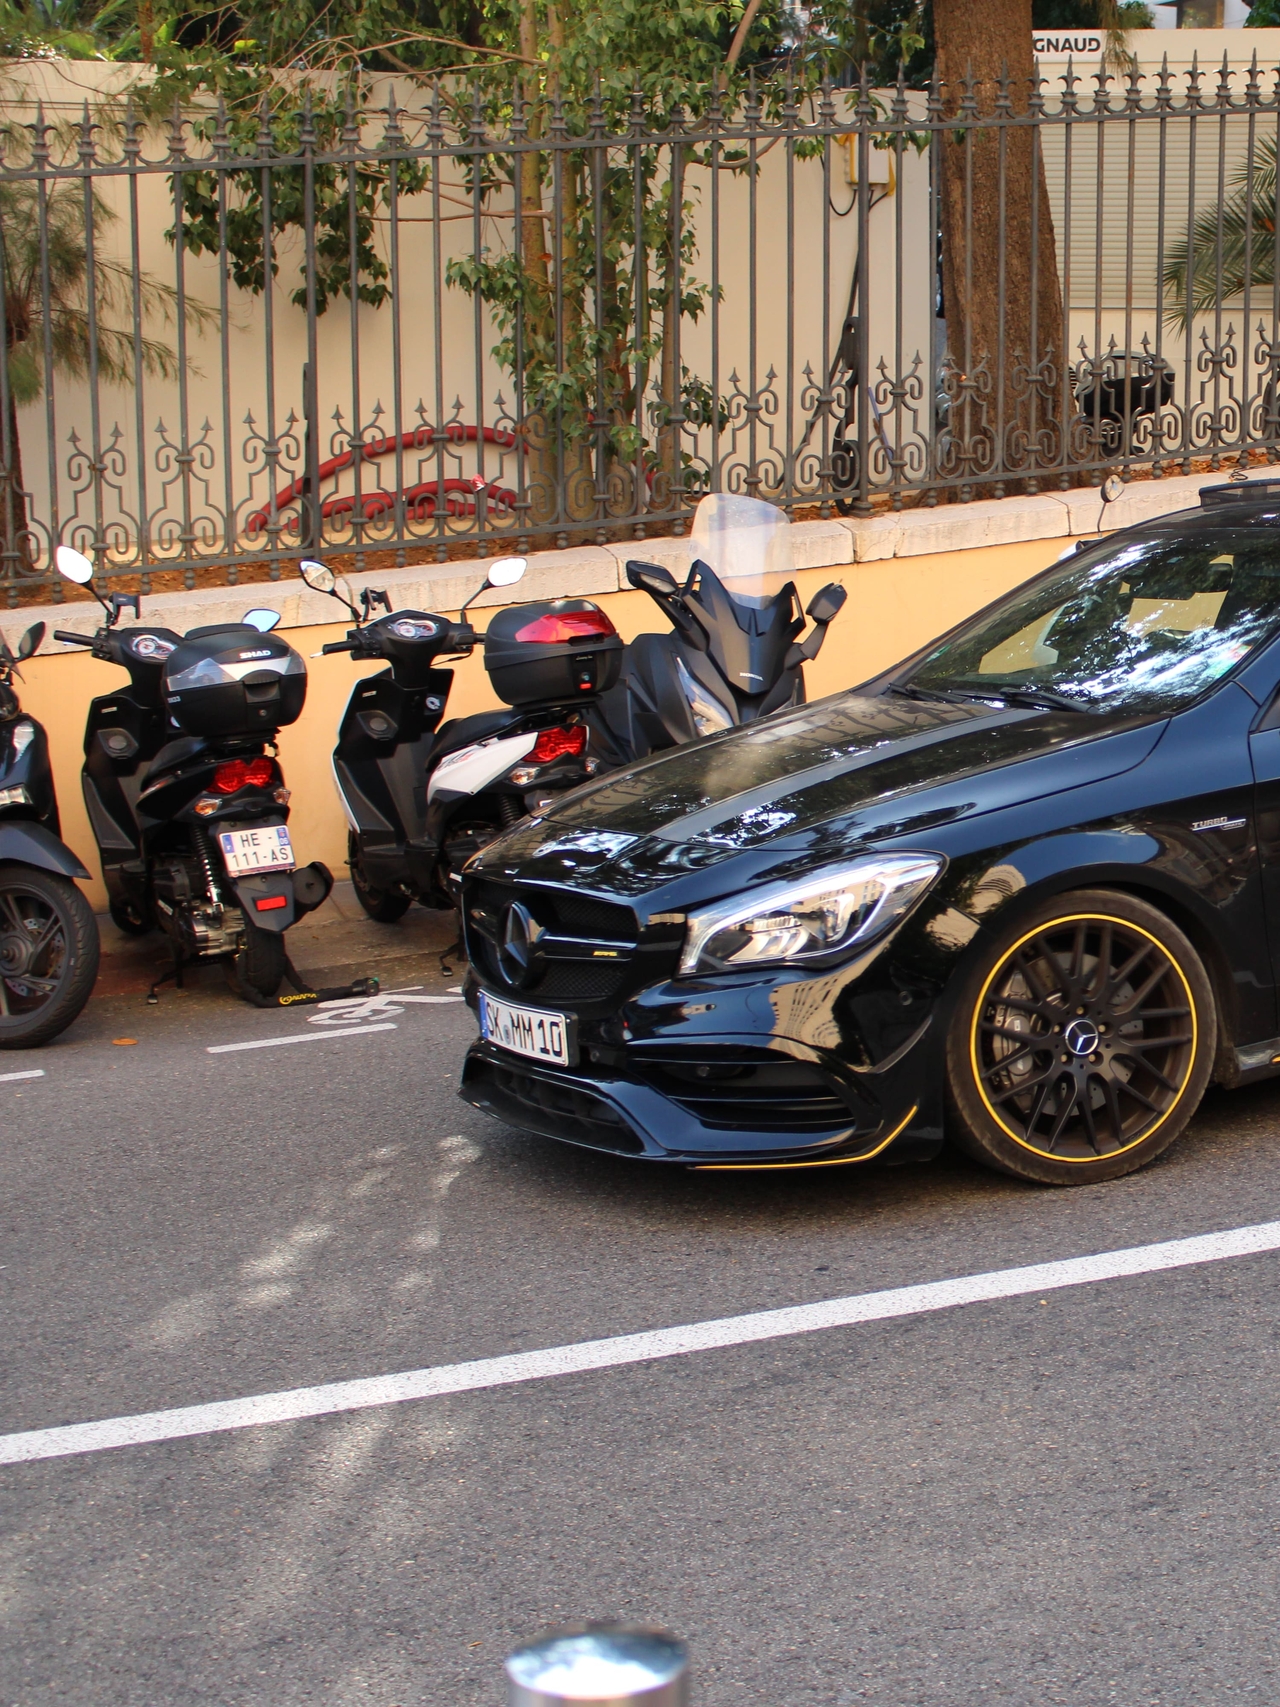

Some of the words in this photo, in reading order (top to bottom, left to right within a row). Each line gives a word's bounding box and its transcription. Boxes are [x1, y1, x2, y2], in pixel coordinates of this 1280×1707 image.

[239, 649, 272, 659] SHAD
[1191, 816, 1228, 829] TURBO
[240, 832, 261, 848] HE
[232, 847, 289, 867] 111-AS
[486, 1001, 504, 1041] SK
[509, 1010, 536, 1051] MM
[538, 1018, 564, 1058] 10
